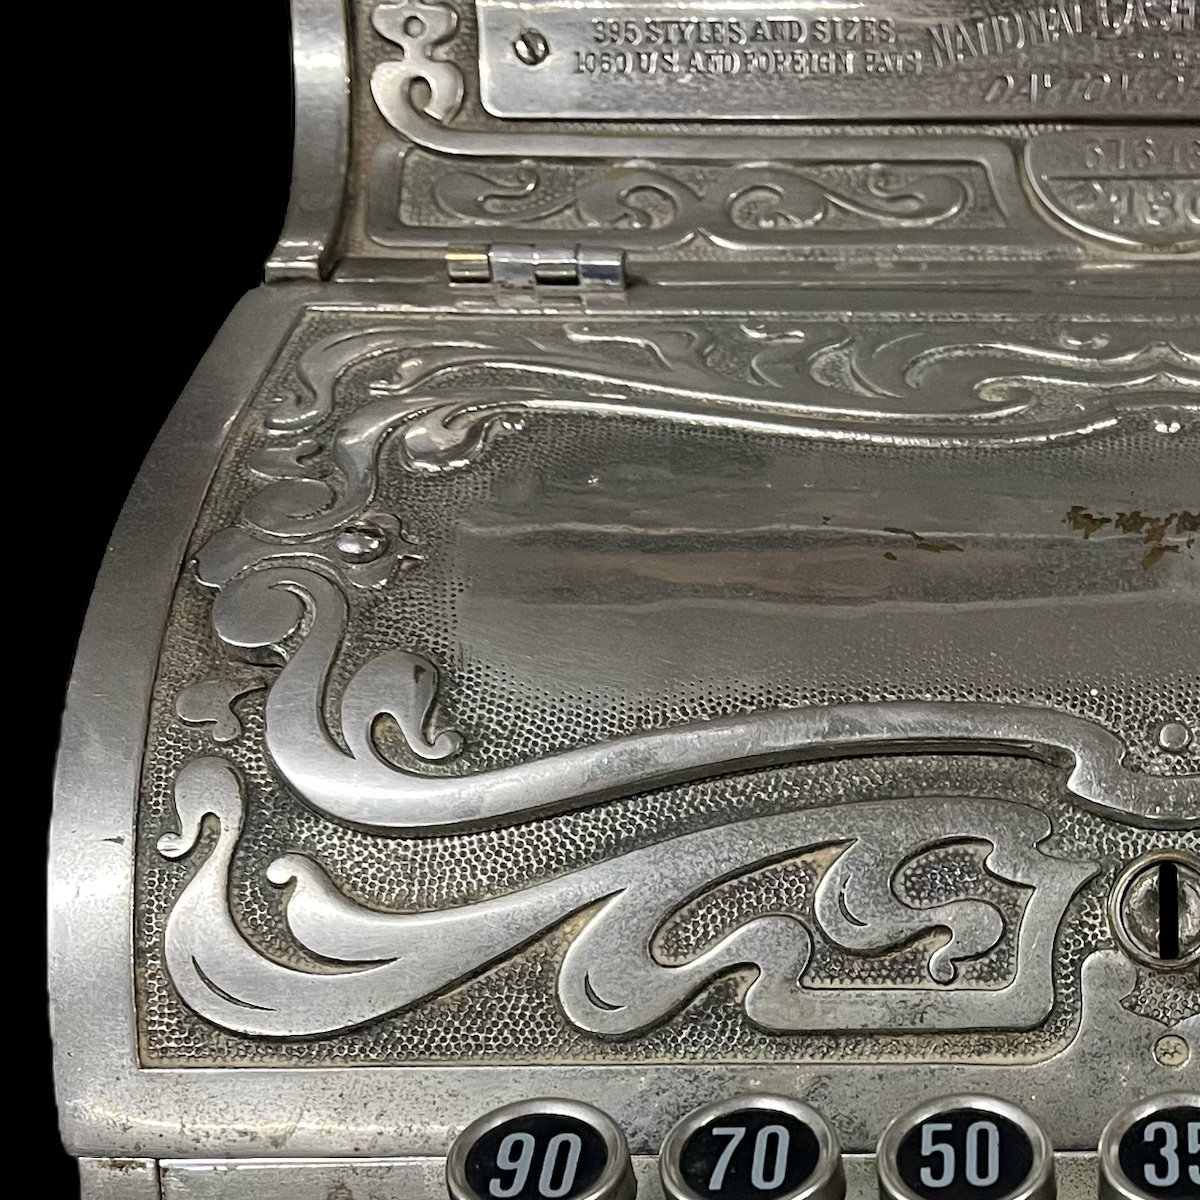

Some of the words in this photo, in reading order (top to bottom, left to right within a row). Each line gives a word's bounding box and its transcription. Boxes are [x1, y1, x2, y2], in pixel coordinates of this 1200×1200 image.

[645, 16, 748, 46] STYLES
[749, 16, 808, 45] AND
[811, 16, 898, 45] SIZES
[686, 50, 741, 76] AND
[743, 50, 857, 76] FOREIGN
[490, 1133, 583, 1199] 90
[707, 1124, 790, 1191] 70
[920, 1120, 1000, 1188] 50
